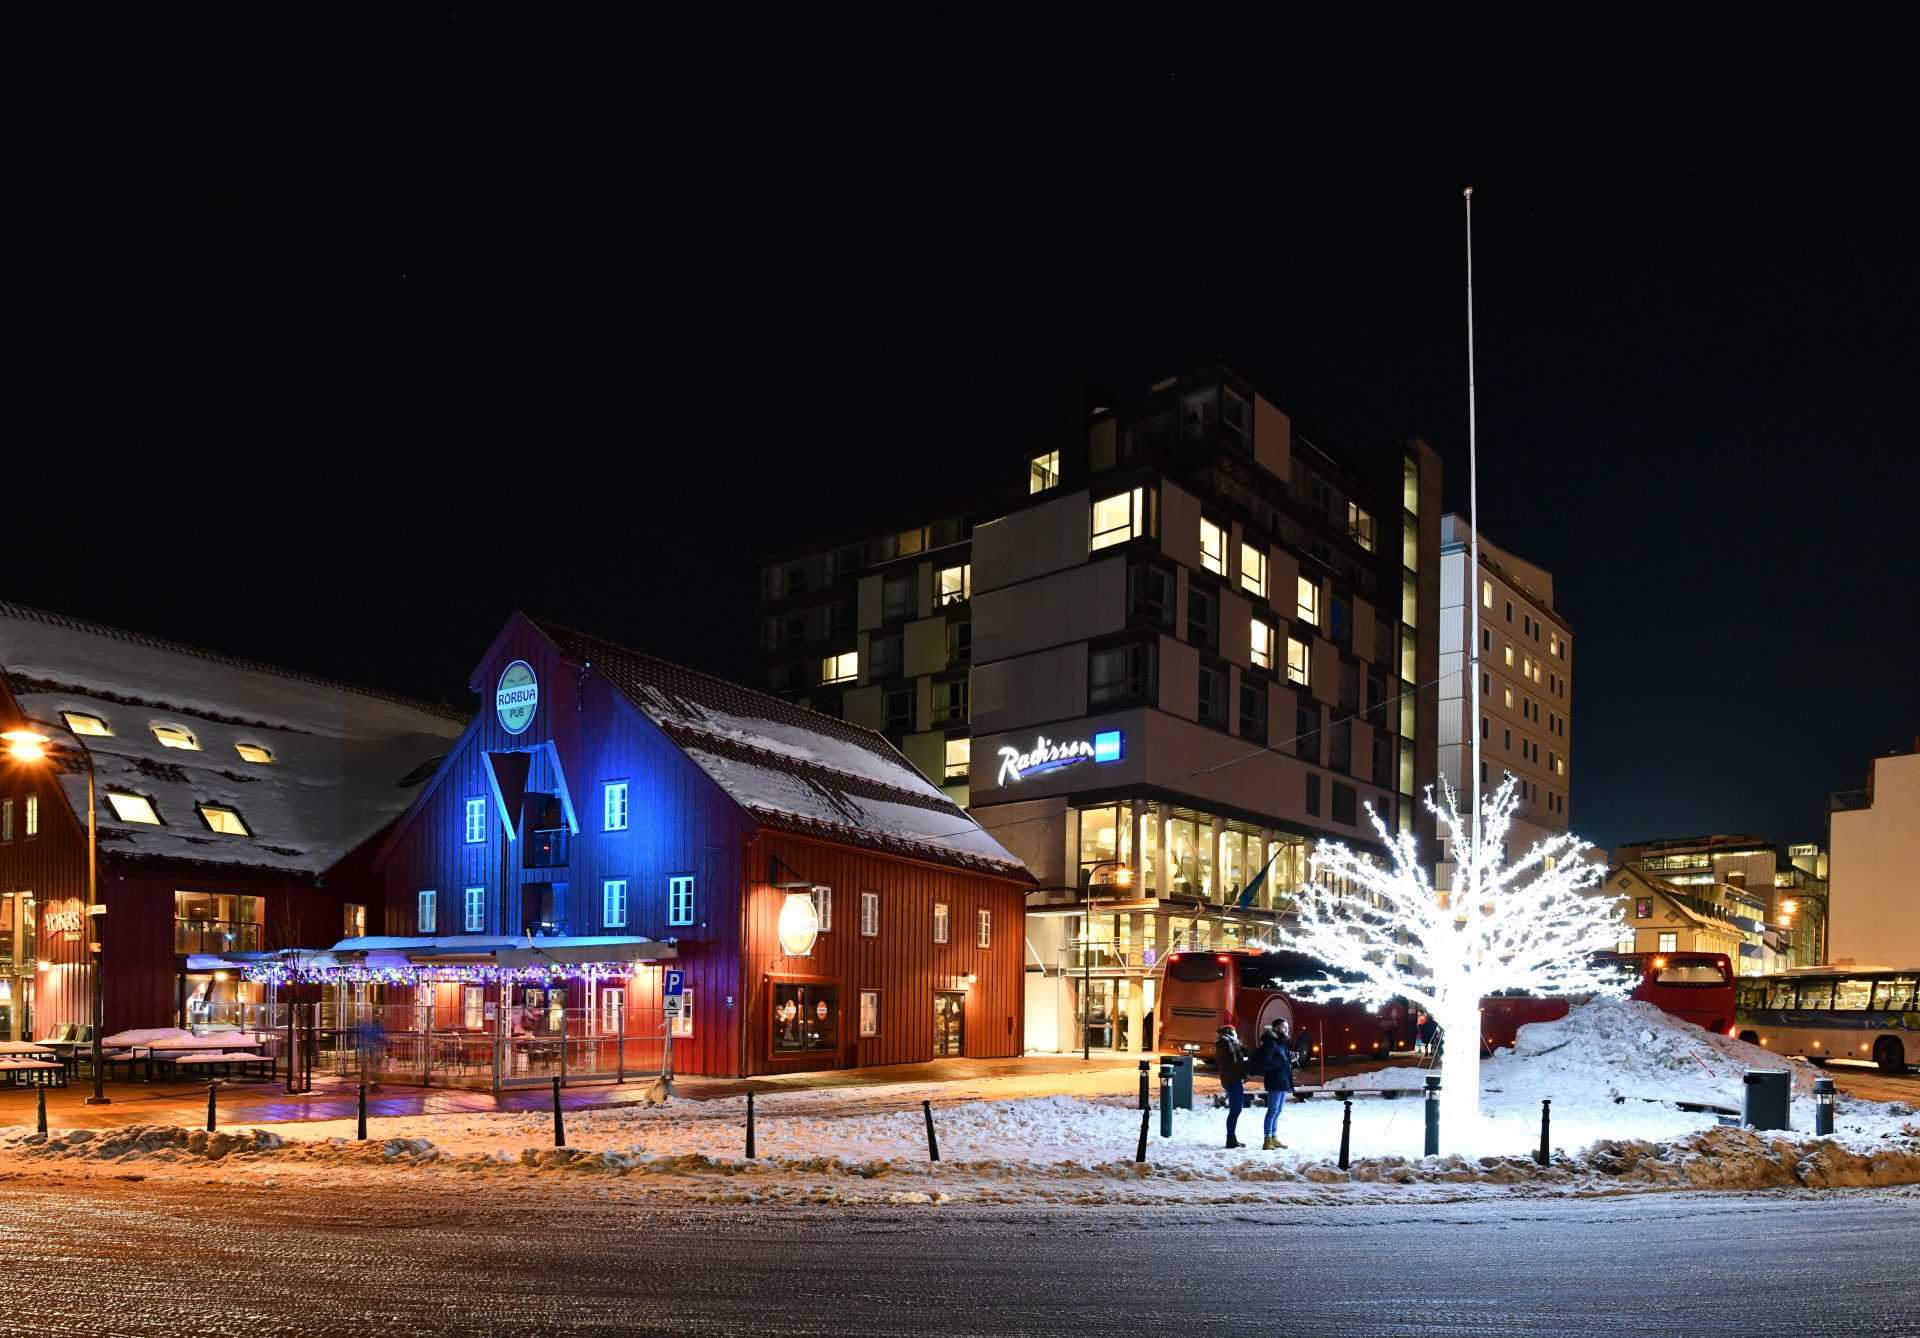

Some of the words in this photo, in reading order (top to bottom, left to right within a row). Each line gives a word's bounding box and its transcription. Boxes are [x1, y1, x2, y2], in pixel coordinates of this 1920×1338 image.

[499, 689, 536, 706] RORBUA
[510, 708, 524, 719] PUB
[998, 735, 1095, 787] Radisson
[45, 912, 81, 932] YONAS
[669, 974, 680, 993] P
